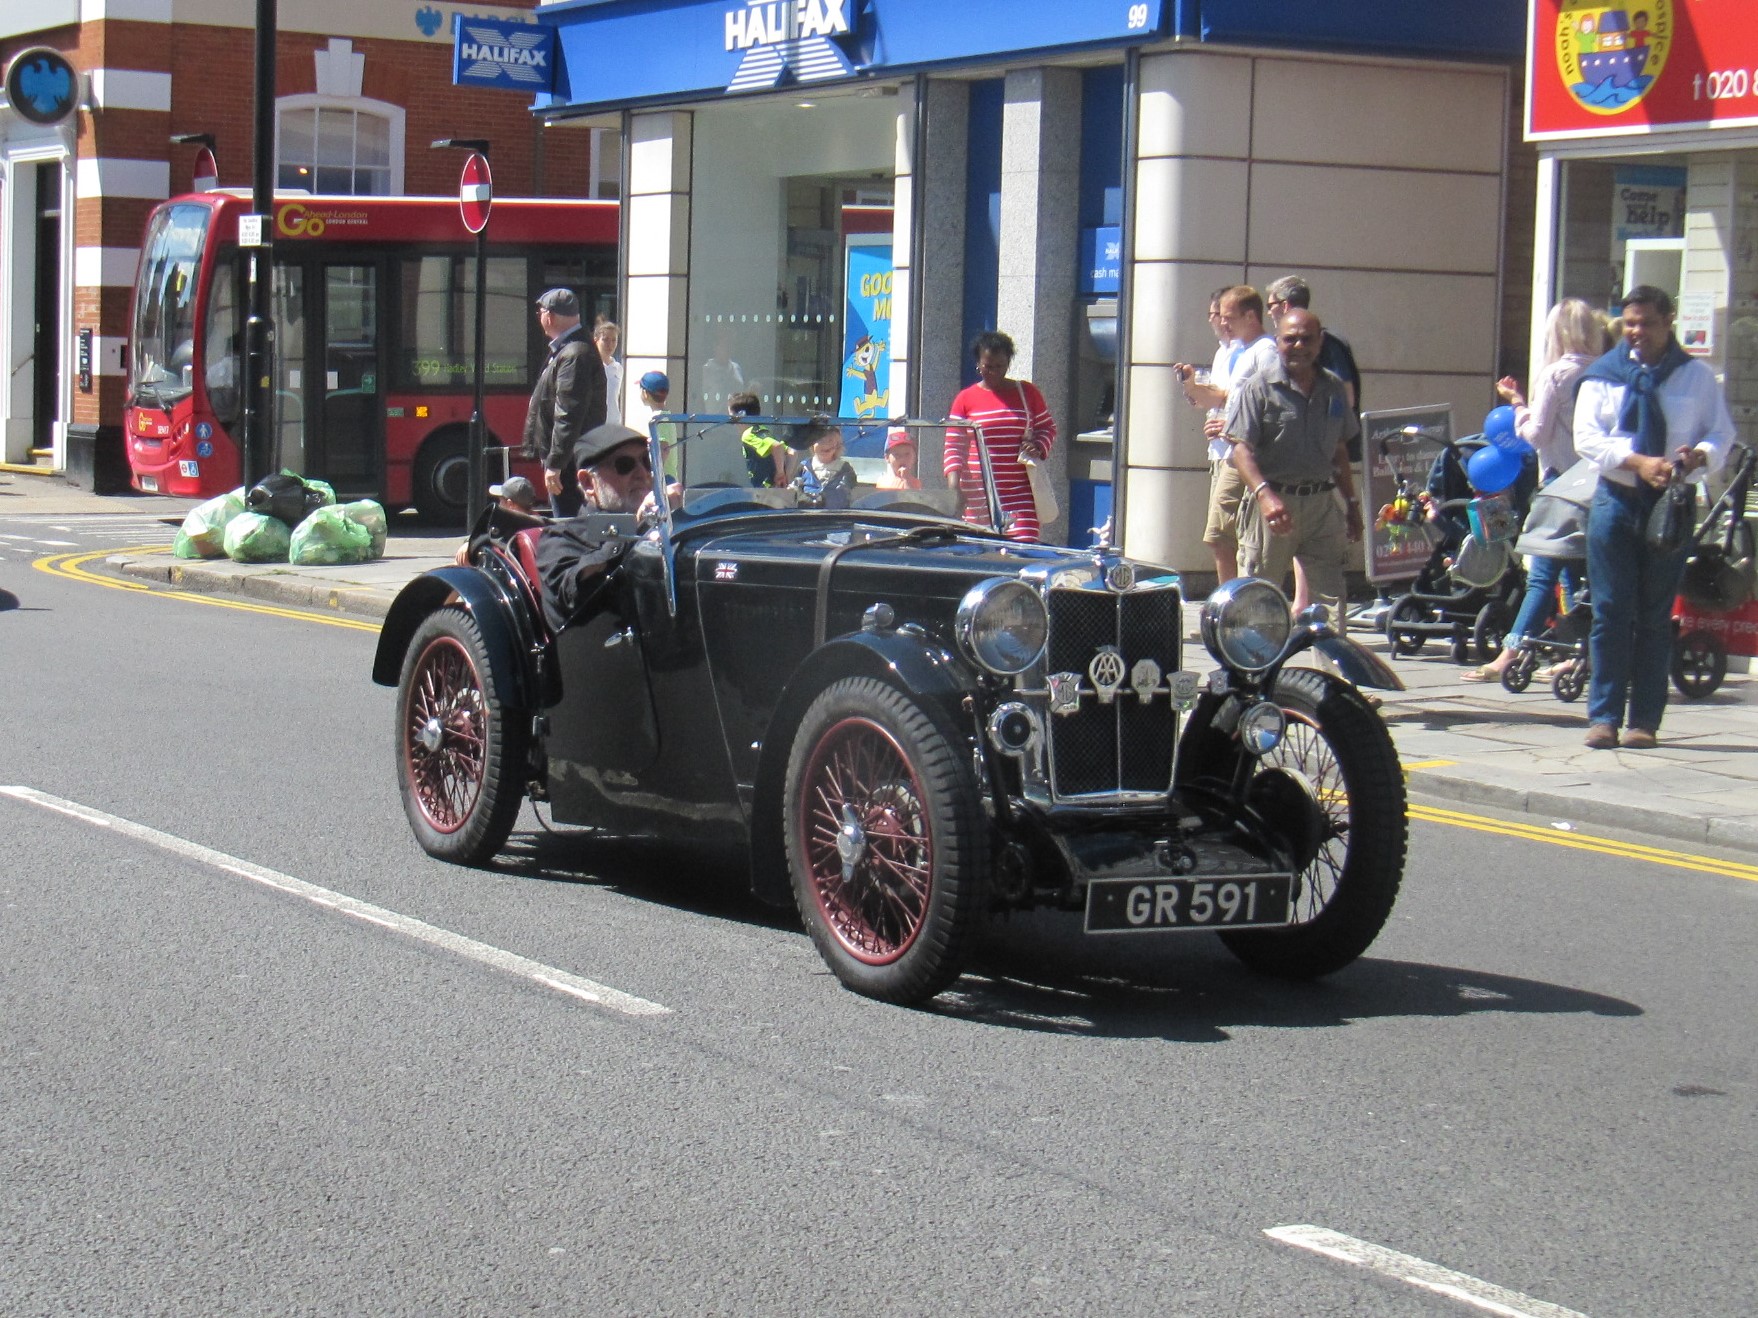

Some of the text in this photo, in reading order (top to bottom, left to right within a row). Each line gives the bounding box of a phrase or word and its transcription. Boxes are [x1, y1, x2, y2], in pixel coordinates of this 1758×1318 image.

[725, 0, 848, 51] HALIFAX
[1128, 3, 1148, 29] 99
[462, 43, 547, 67] HALIFAX
[1706, 69, 1748, 100] 020
[278, 203, 324, 236] Go
[1625, 204, 1671, 231] help
[1090, 267, 1107, 278] cash
[412, 360, 440, 377] 399
[1113, 564, 1130, 587] MG
[1096, 653, 1118, 686] AA
[1126, 882, 1257, 925] GR 591
